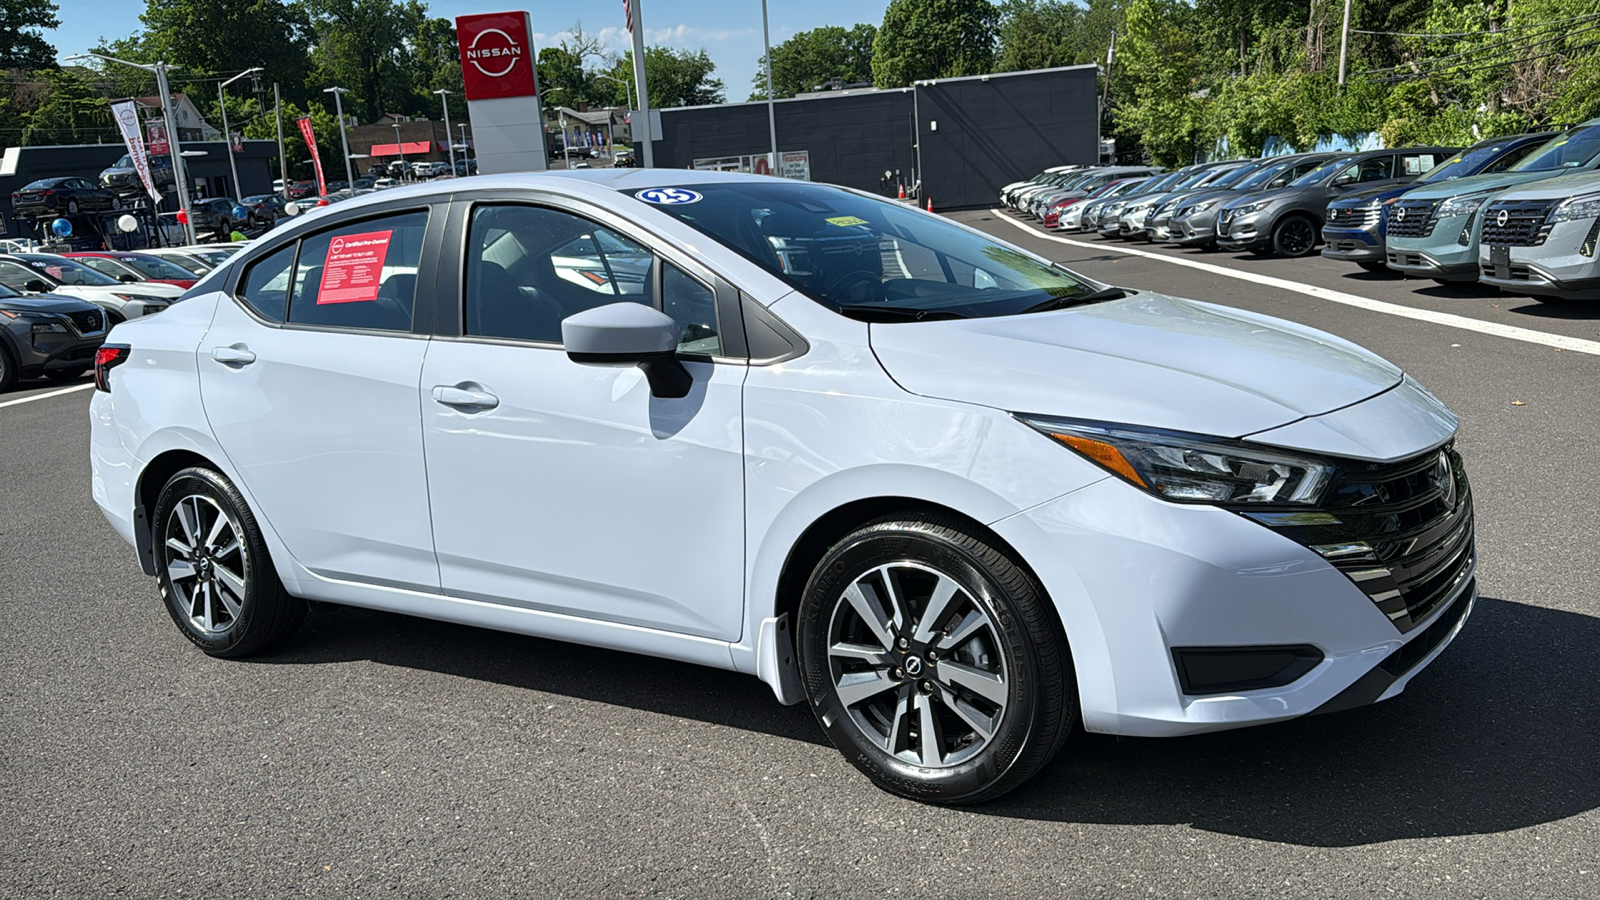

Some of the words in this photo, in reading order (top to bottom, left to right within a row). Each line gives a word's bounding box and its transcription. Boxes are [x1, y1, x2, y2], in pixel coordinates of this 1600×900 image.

[467, 47, 521, 59] NISSAN
[783, 155, 807, 163] Financing
[647, 188, 690, 204] 25
[363, 238, 388, 246] Pre-Owned
[807, 560, 846, 623] KUMHO
[988, 596, 1026, 677] SOLUS
